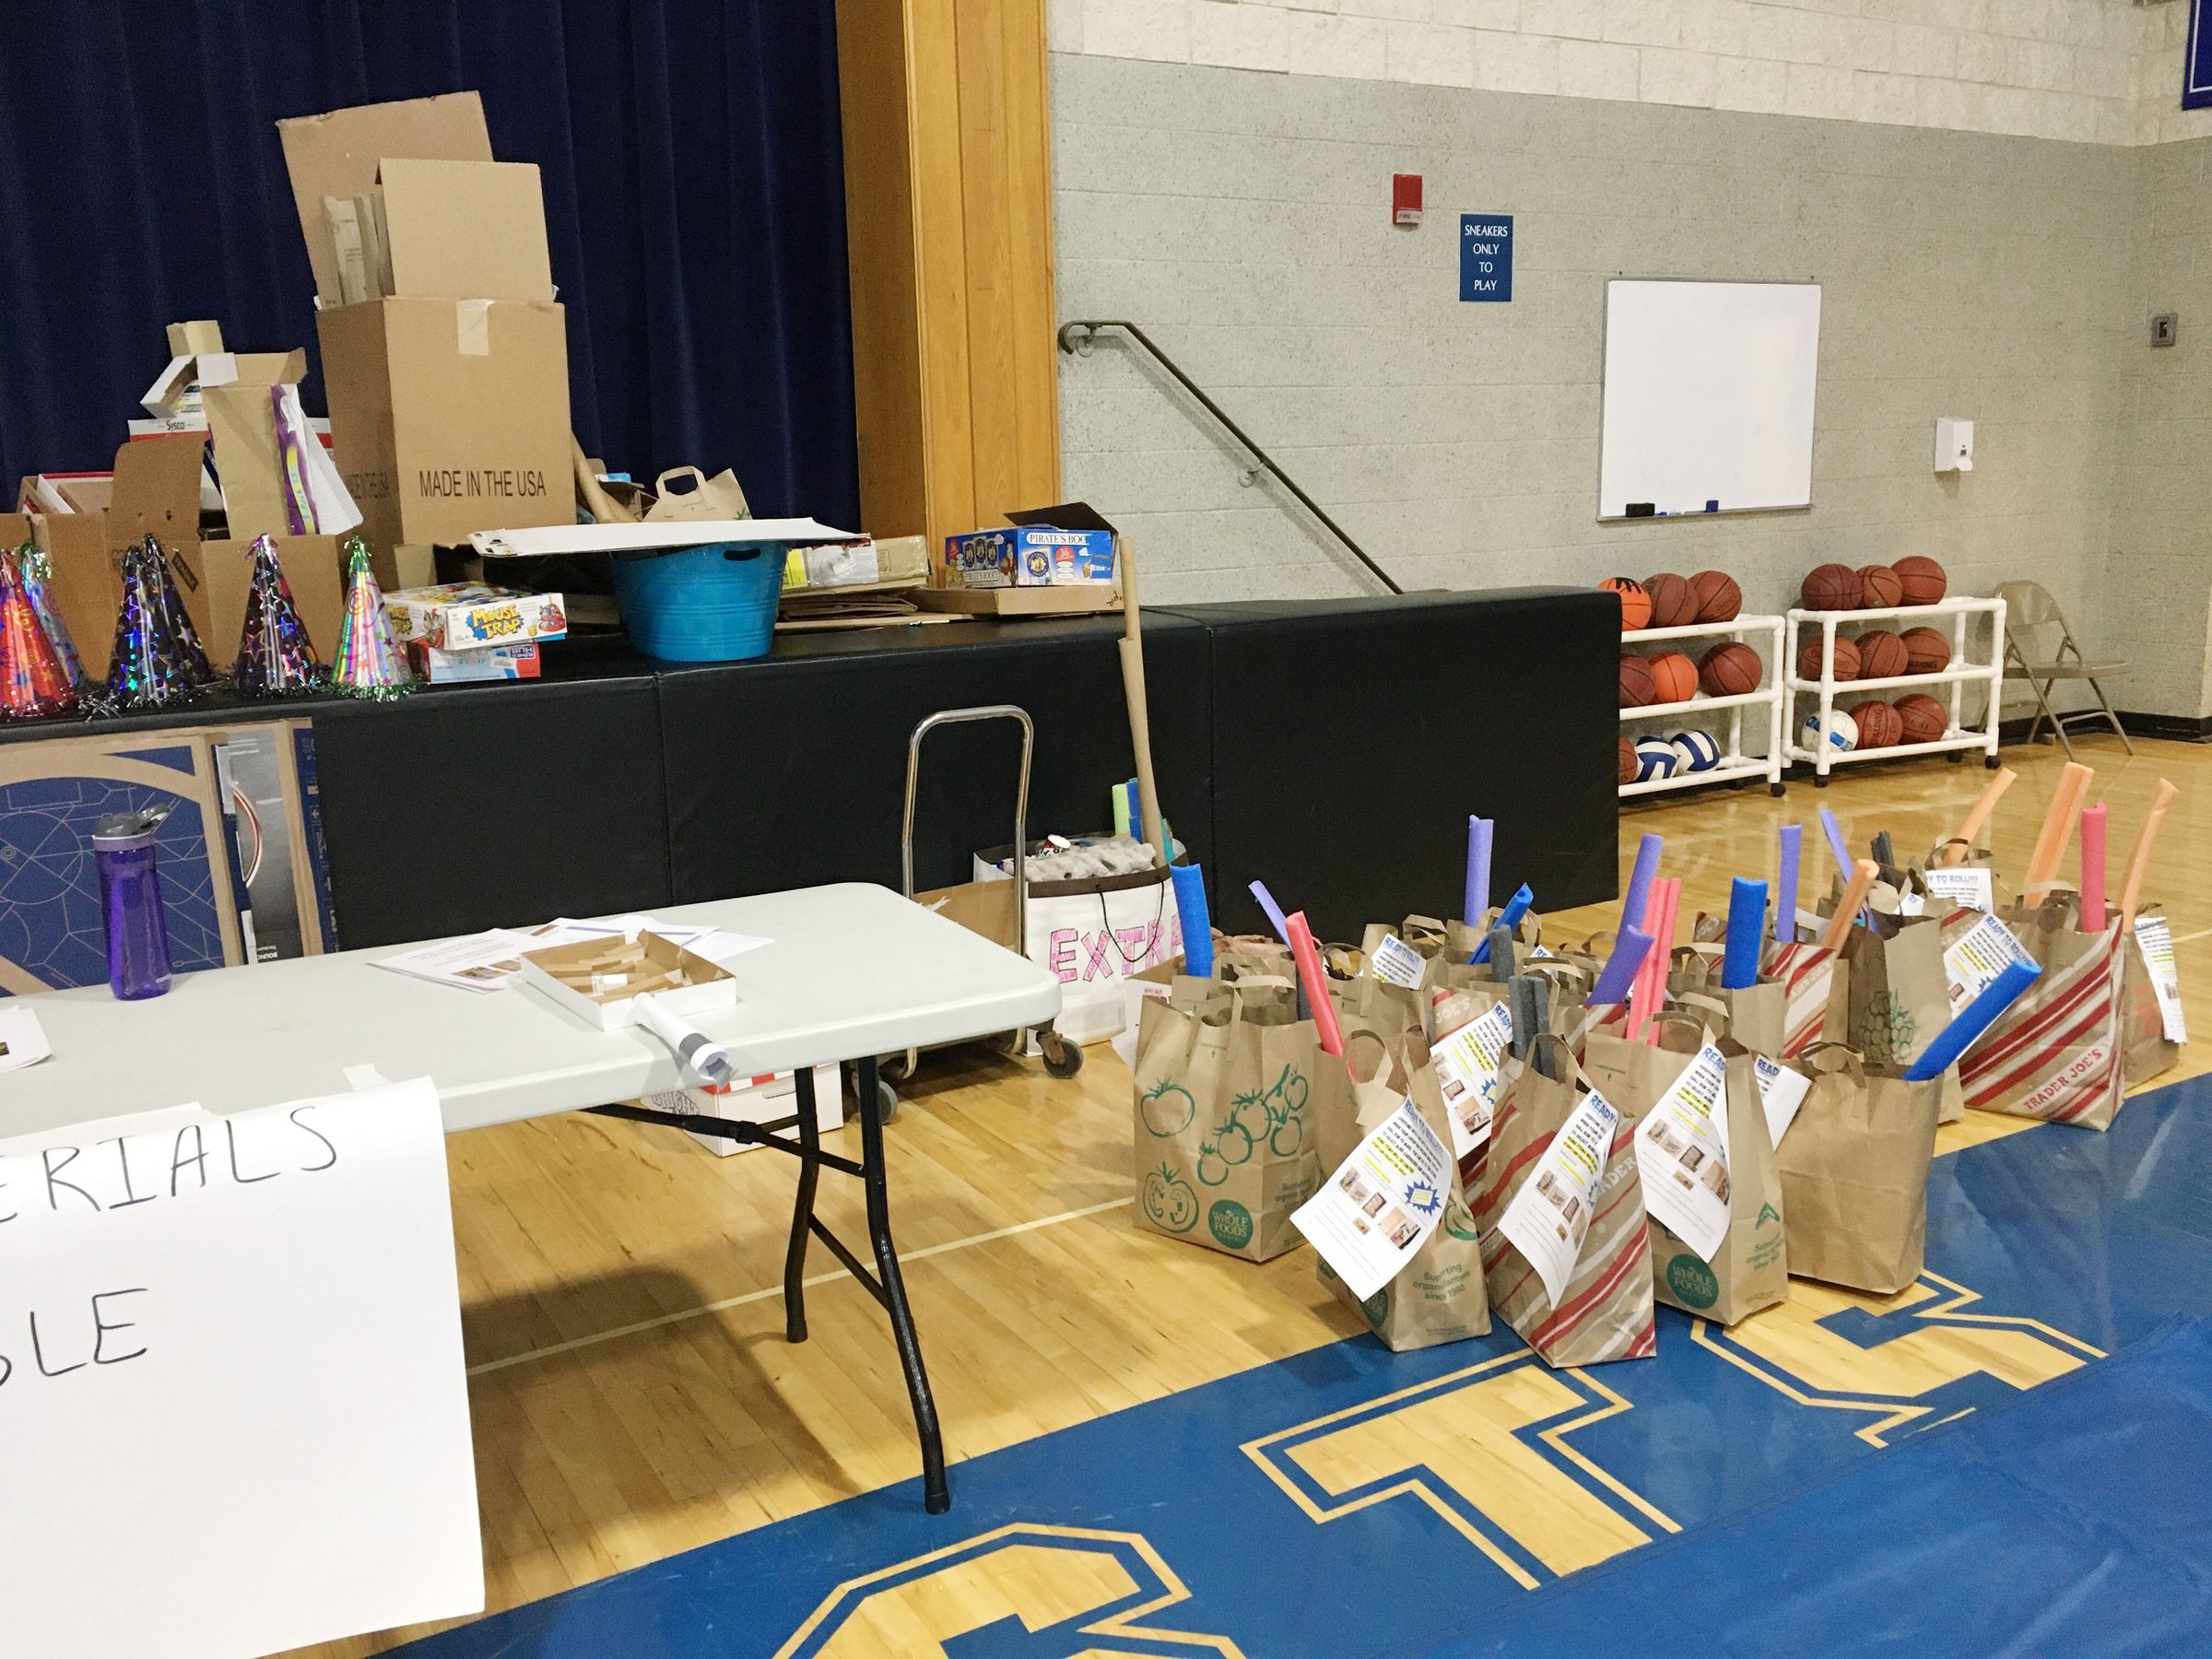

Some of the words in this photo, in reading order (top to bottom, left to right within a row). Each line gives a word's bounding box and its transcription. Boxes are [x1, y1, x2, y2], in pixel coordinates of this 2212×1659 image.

[1465, 224, 1508, 238] SNEAKERS
[1473, 243, 1500, 255] ONLY
[1478, 262, 1493, 273] TO
[1474, 279, 1498, 291] PLAY
[166, 419, 184, 431] Sysco
[419, 470, 463, 497] MADE
[466, 470, 481, 497] IN
[484, 470, 512, 497] THE
[516, 470, 547, 497] USA
[471, 604, 520, 627] MOUSE
[481, 618, 522, 641] TRAP
[1436, 997, 1472, 1024] JOE'S
[2023, 1075, 2070, 1111] TRADER
[2070, 1047, 2103, 1077] JOE'S
[1212, 1211, 1248, 1229] WHOLE
[1214, 1223, 1247, 1238] FOODS
[1672, 1265, 1712, 1288] WHOLE
[1674, 1278, 1712, 1298] FOODS
